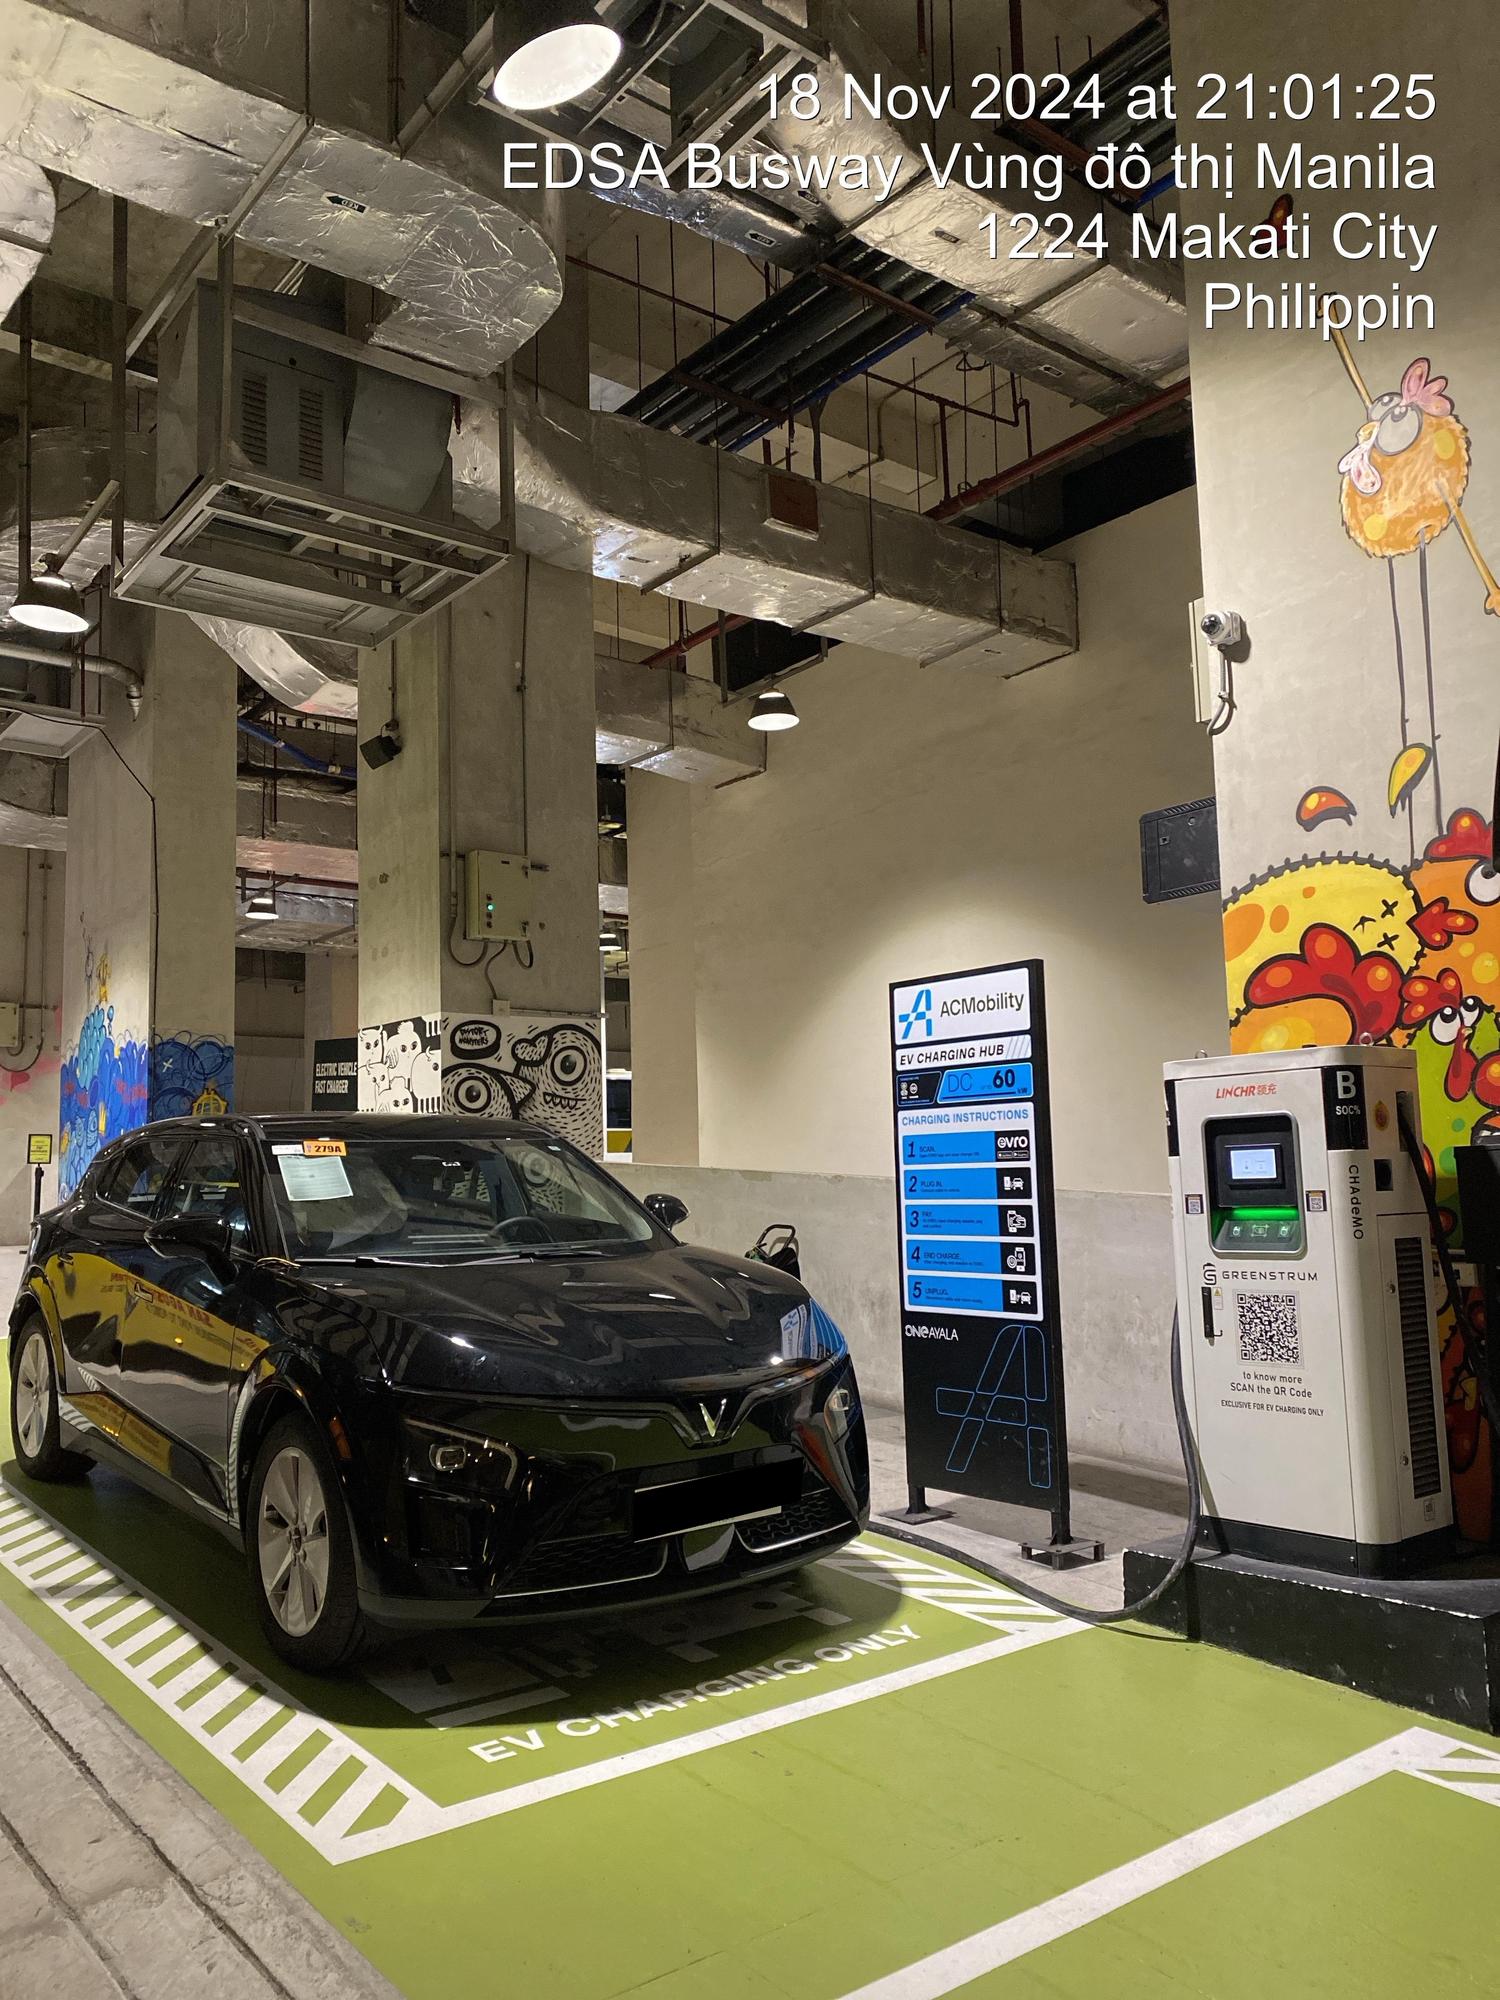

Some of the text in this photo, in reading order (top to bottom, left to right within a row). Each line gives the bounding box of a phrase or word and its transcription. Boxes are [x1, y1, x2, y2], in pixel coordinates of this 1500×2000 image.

[940, 992, 1024, 1017] ACMobility
[900, 1044, 1004, 1065] EV CHARGING HUB
[315, 1061, 358, 1077] ELECTRIC VEHICLE
[314, 1079, 349, 1094] FAST CHARGER
[947, 1068, 1016, 1093] DC 60
[1336, 1070, 1357, 1099] B
[1216, 1086, 1256, 1099] LINCHR
[901, 1109, 1029, 1126] CHARGING INSTRUCTIONS
[1335, 1105, 1361, 1116] SOC%
[314, 1145, 342, 1153] 279A
[907, 1141, 915, 1158] 1
[909, 1175, 918, 1193] 2
[1348, 1164, 1364, 1240] CHAdeMO
[910, 1210, 919, 1228] 3
[911, 1246, 920, 1263] 4
[1222, 1270, 1319, 1281] GREENSTRUM
[913, 1281, 922, 1299] 5
[1243, 1371, 1303, 1384] to know more
[1230, 1382, 1313, 1398] SCAN the QR Code
[1221, 1399, 1325, 1417] EXCLUSIVE FOR EV CHARGING ONLY
[467, 1623, 922, 1764] EV CHARGING ONLY
